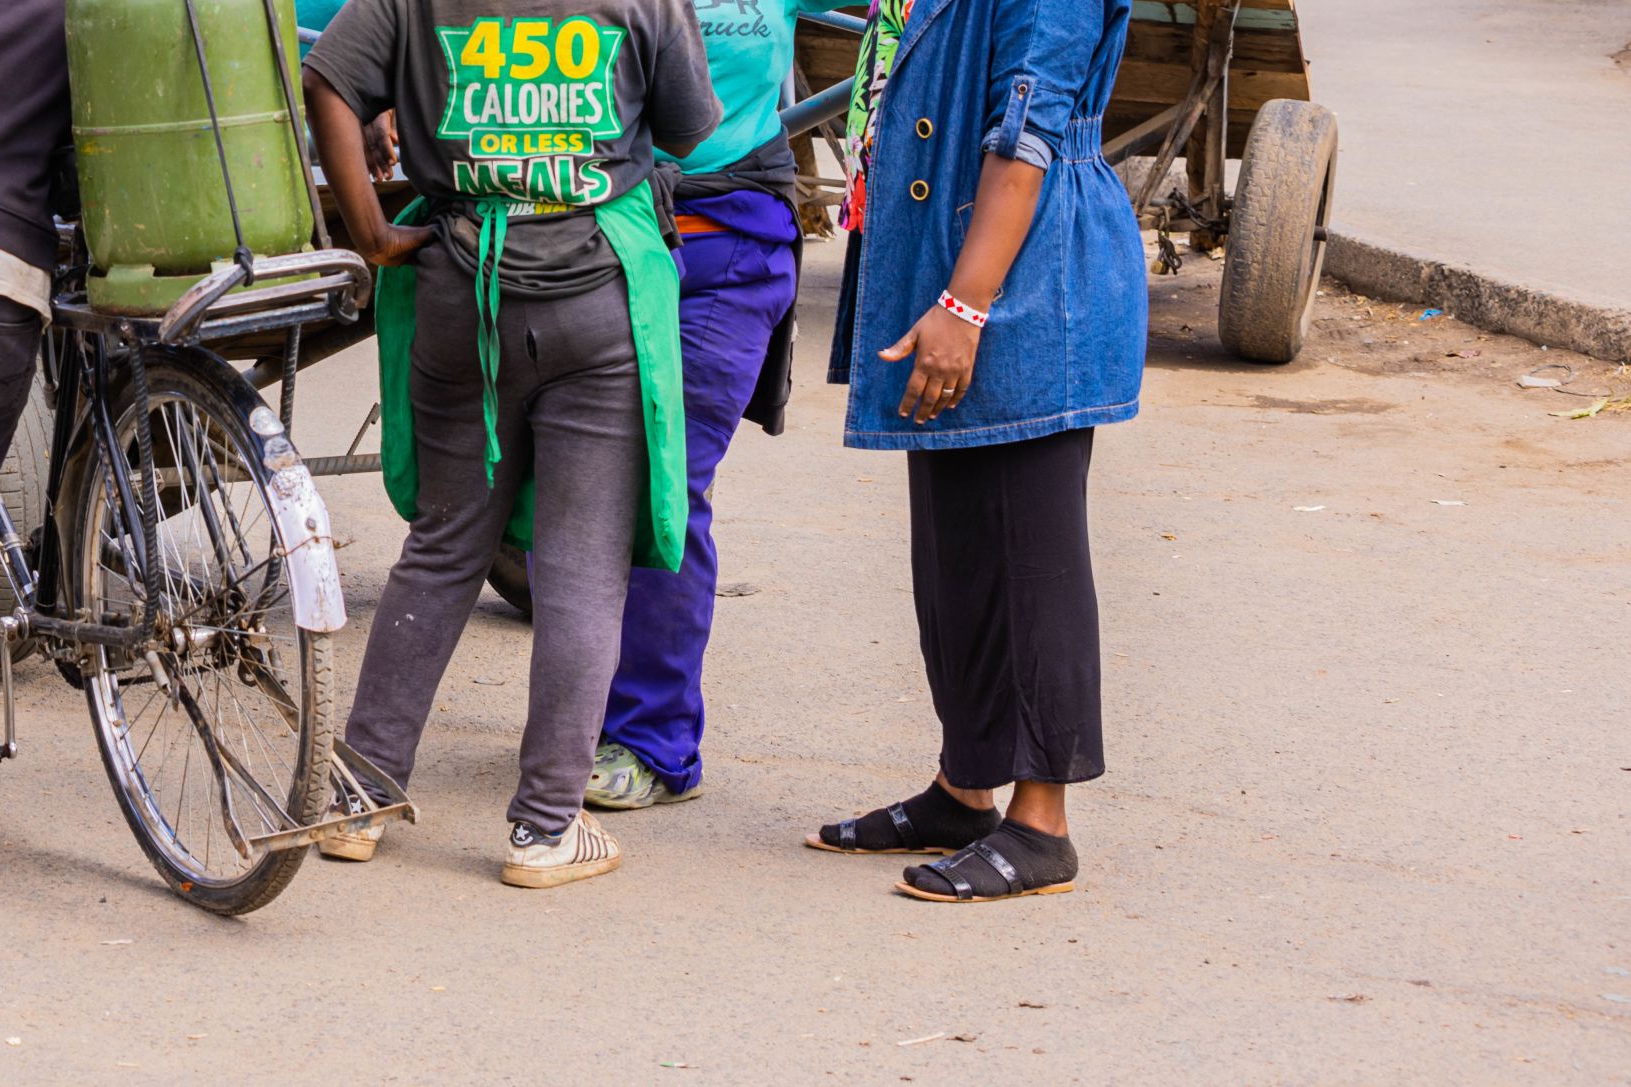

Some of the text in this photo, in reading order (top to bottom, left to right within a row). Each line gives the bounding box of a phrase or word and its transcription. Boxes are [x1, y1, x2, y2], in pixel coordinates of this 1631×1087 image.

[698, 14, 772, 38] ruck
[460, 20, 600, 80] 450
[464, 81, 603, 126] CALORIES
[480, 132, 584, 154] OR LESS
[453, 156, 613, 206] MEALS
